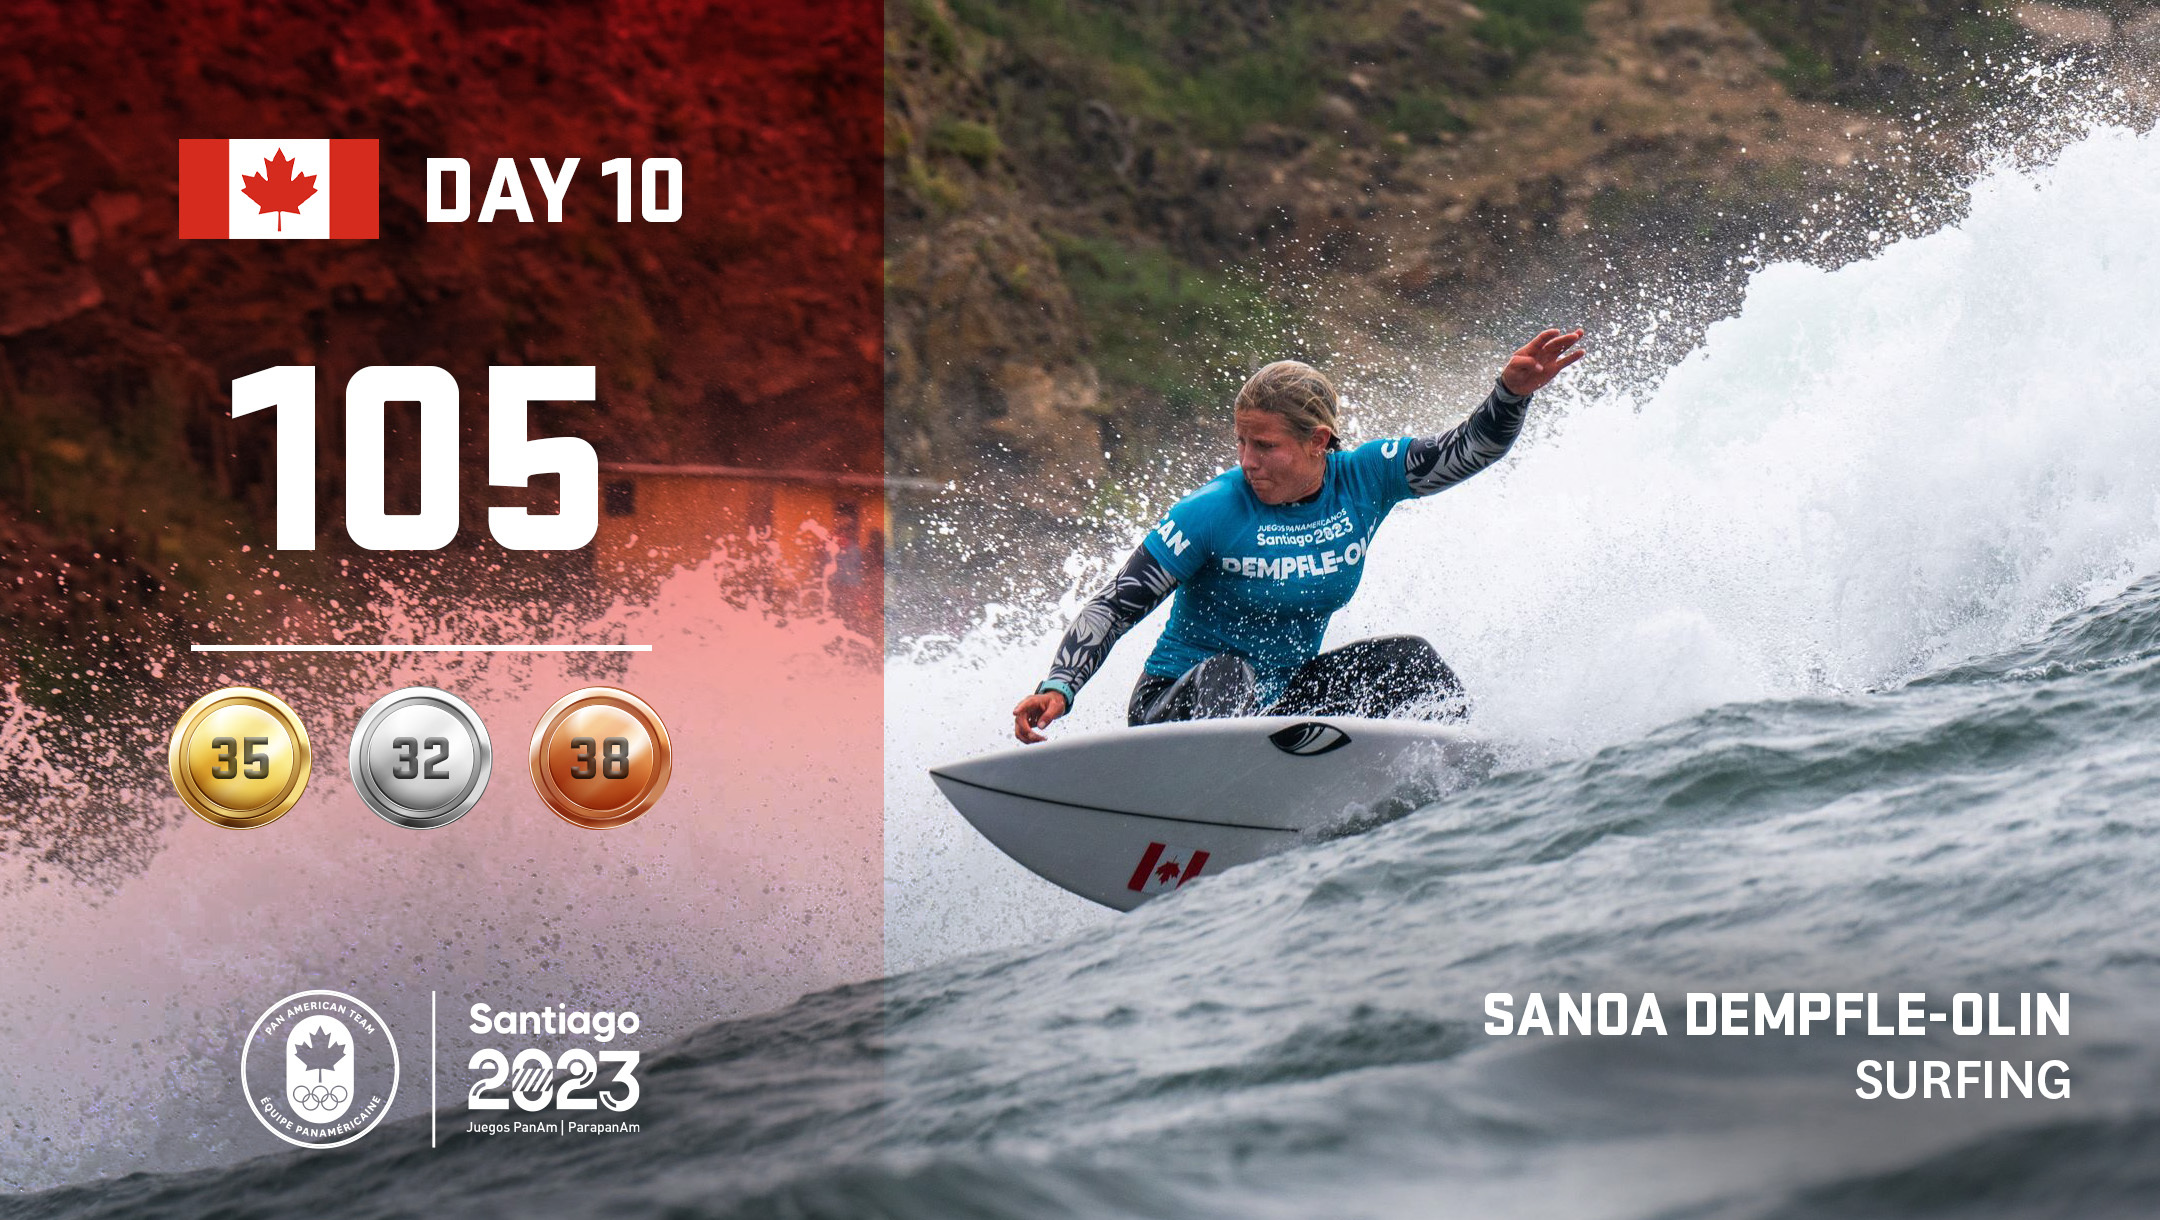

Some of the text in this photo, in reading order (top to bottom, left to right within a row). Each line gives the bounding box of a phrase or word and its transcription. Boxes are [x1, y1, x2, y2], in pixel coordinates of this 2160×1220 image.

[1256, 516, 1354, 547] Santiago 2023
[1257, 507, 1347, 533] JUEGOS PANAMERICANOS
